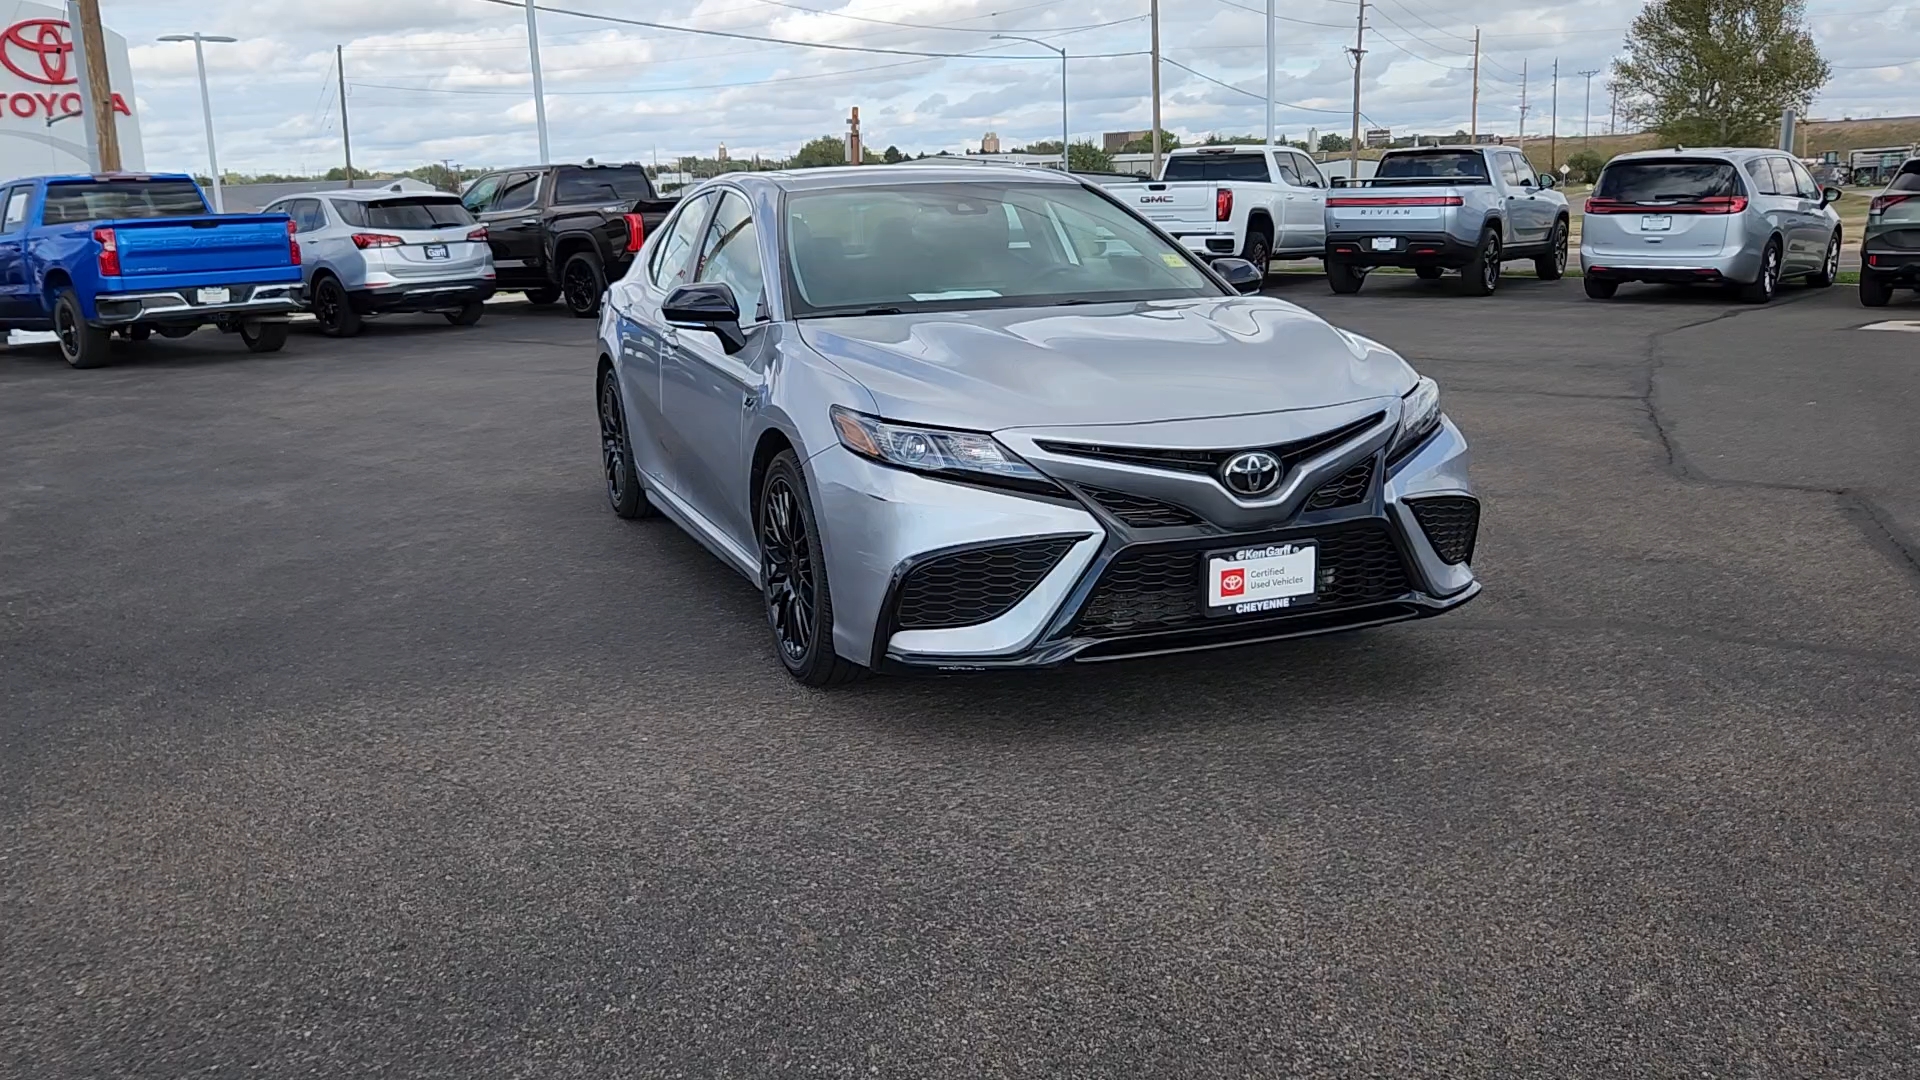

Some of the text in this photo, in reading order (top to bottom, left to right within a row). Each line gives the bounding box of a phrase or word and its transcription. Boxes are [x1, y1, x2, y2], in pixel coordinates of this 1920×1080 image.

[0, 92, 131, 118] OYOA
[1140, 195, 1174, 204] GMC
[1246, 544, 1292, 560] Ken Garff
[1250, 567, 1285, 578] Certified
[1250, 576, 1304, 589] Used Vehicles
[1235, 597, 1290, 614] CHEYENNE
